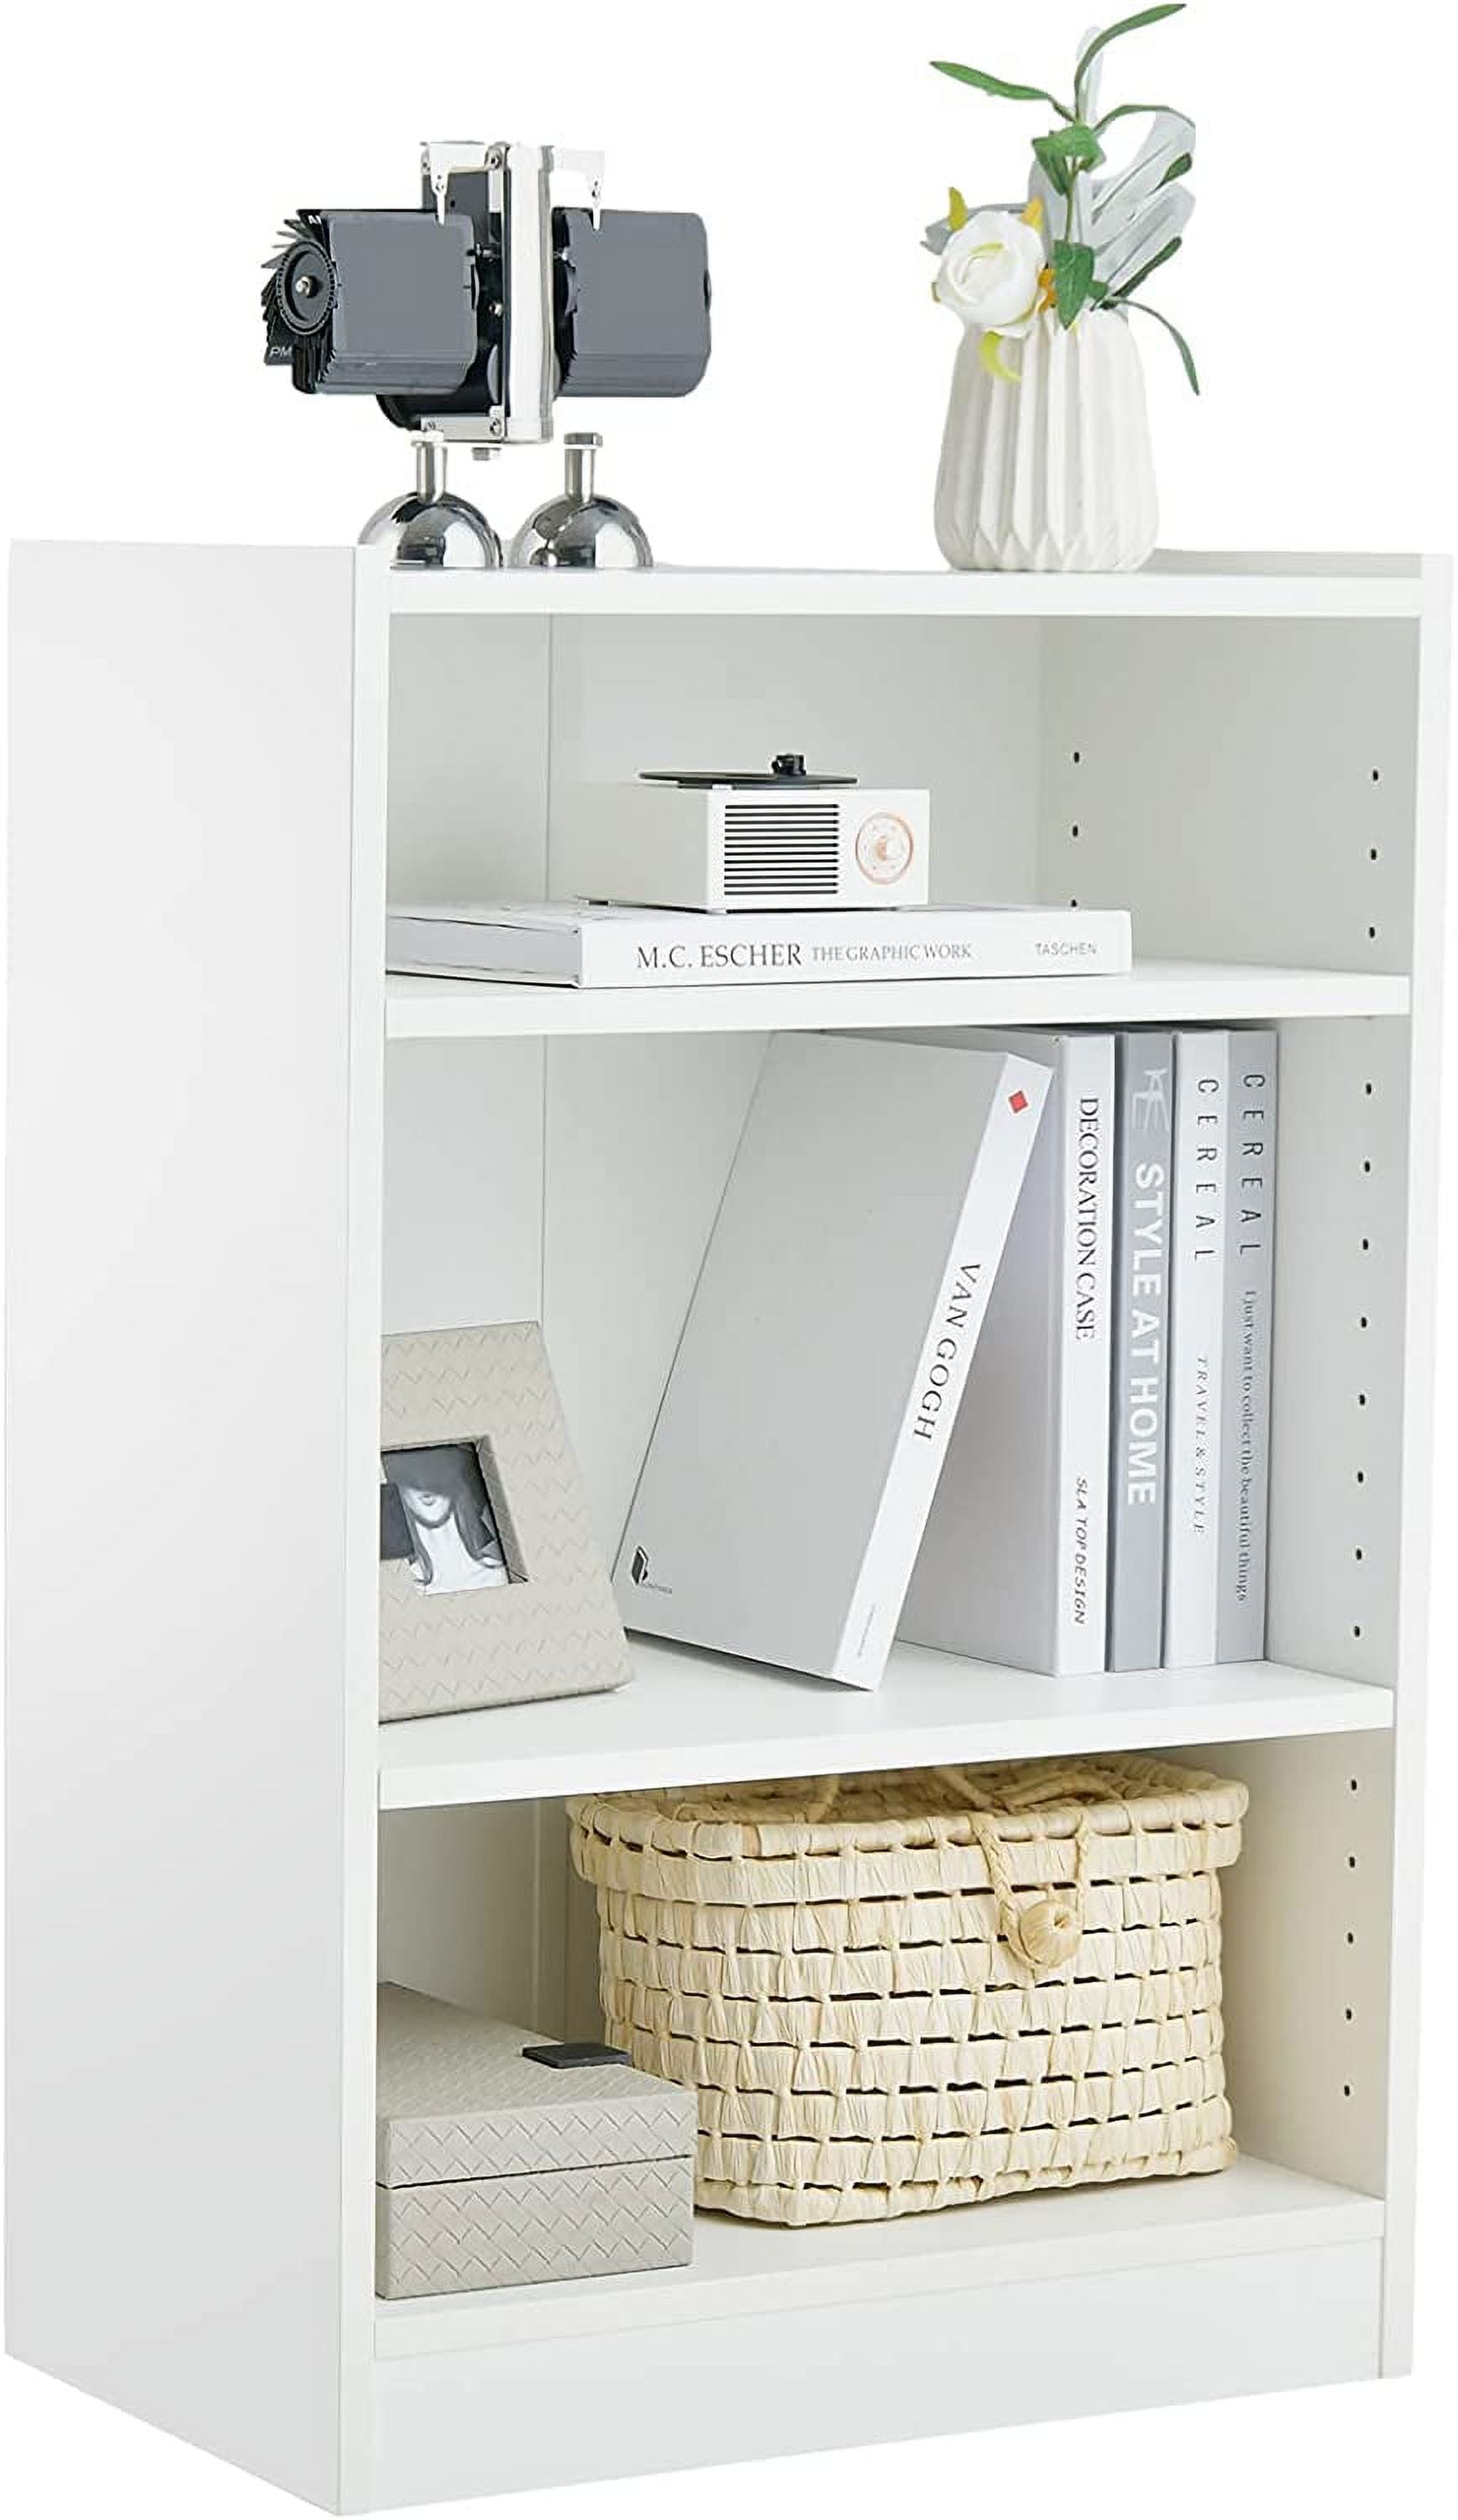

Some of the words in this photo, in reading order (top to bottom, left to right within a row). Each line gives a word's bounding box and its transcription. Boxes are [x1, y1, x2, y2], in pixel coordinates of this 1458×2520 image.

[637, 945, 693, 968] M.C.
[700, 942, 802, 967] ESCHER
[811, 946, 844, 962] THE
[846, 944, 920, 962] GRAPHIC
[922, 942, 972, 959] WORK
[1035, 942, 1098, 956] TASCHEN
[1078, 1097, 1100, 1265] DECORATION
[1194, 1079, 1219, 1261] CEREAL
[1240, 1074, 1266, 1256] CEREAL
[1131, 1162, 1165, 1297] STYLE
[945, 1263, 982, 1328] VAN
[1076, 1273, 1095, 1341] CASE
[1243, 1298, 1256, 1328] just
[1130, 1309, 1160, 1364] AT
[1243, 1331, 1254, 1372] want
[913, 1337, 957, 1440] GOGH
[1195, 1357, 1209, 1439] TRAVEL
[1243, 1376, 1254, 1392] to
[1127, 1377, 1159, 1506] HOME
[1196, 1446, 1206, 1457] &
[1241, 1394, 1255, 1445] collect
[1241, 1449, 1253, 1475] the
[1193, 1466, 1206, 1533] STYLE
[1239, 1478, 1252, 1547] beautiful
[1075, 1517, 1088, 1551] TOP
[1074, 1553, 1087, 1625] DESIGN
[1236, 1552, 1251, 1601] things
